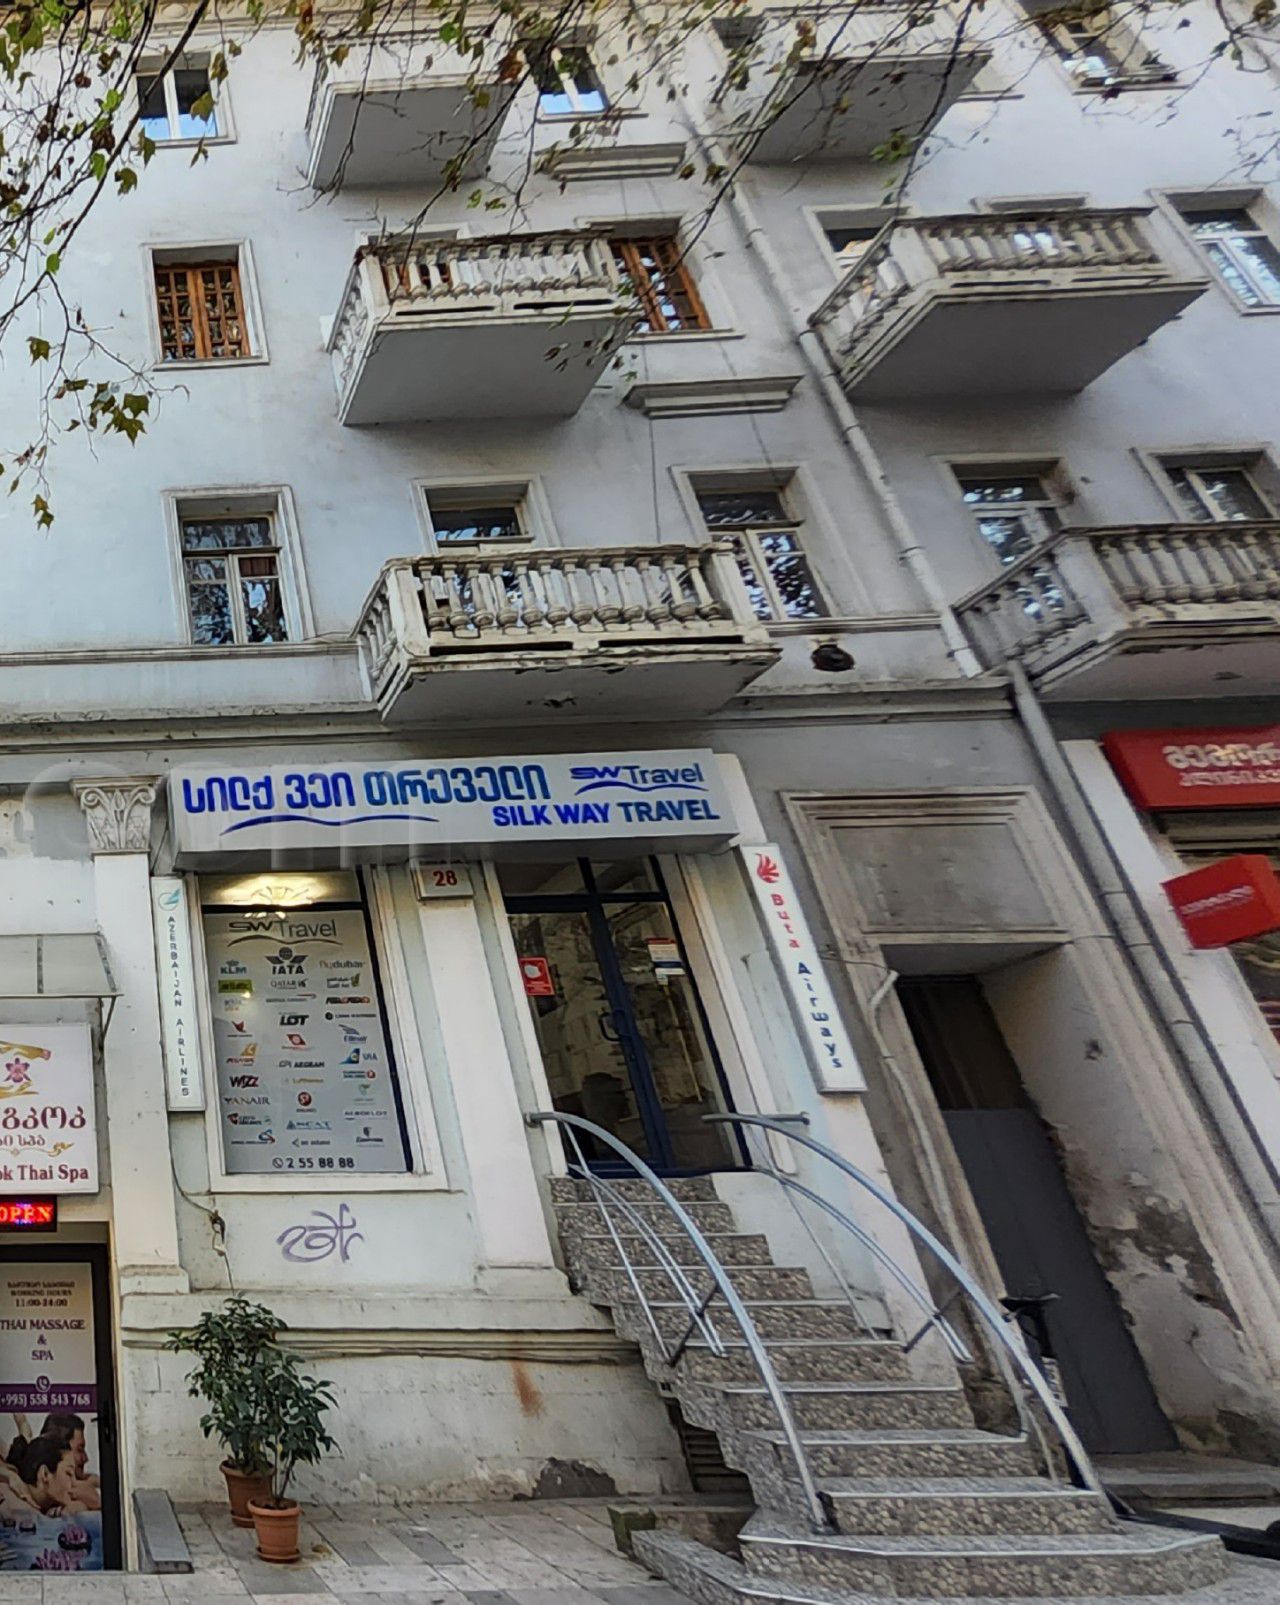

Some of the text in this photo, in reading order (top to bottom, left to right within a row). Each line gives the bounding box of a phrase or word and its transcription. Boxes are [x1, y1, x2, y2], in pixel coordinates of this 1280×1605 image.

[182, 764, 551, 814] სილქ ვეი თრეველი
[492, 799, 720, 827] SILK WAY TRAVEL
[433, 870, 458, 887] 28
[220, 966, 247, 974] KLM
[272, 965, 305, 975] IATA
[771, 893, 843, 1069] Buta Airways
[167, 915, 190, 1097] AZERBAIJAN AIRLINES
[280, 1014, 309, 1026] LOT
[229, 1075, 259, 1089] WIZZ
[224, 1096, 270, 1105] YANAIR
[287, 1157, 355, 1168] 2 55 88 88
[17, 1165, 53, 1181] Thai
[58, 1164, 89, 1183] Spa
[29, 1318, 86, 1330] MASSAGE
[36, 1333, 47, 1345] &
[31, 1349, 55, 1361] SPA
